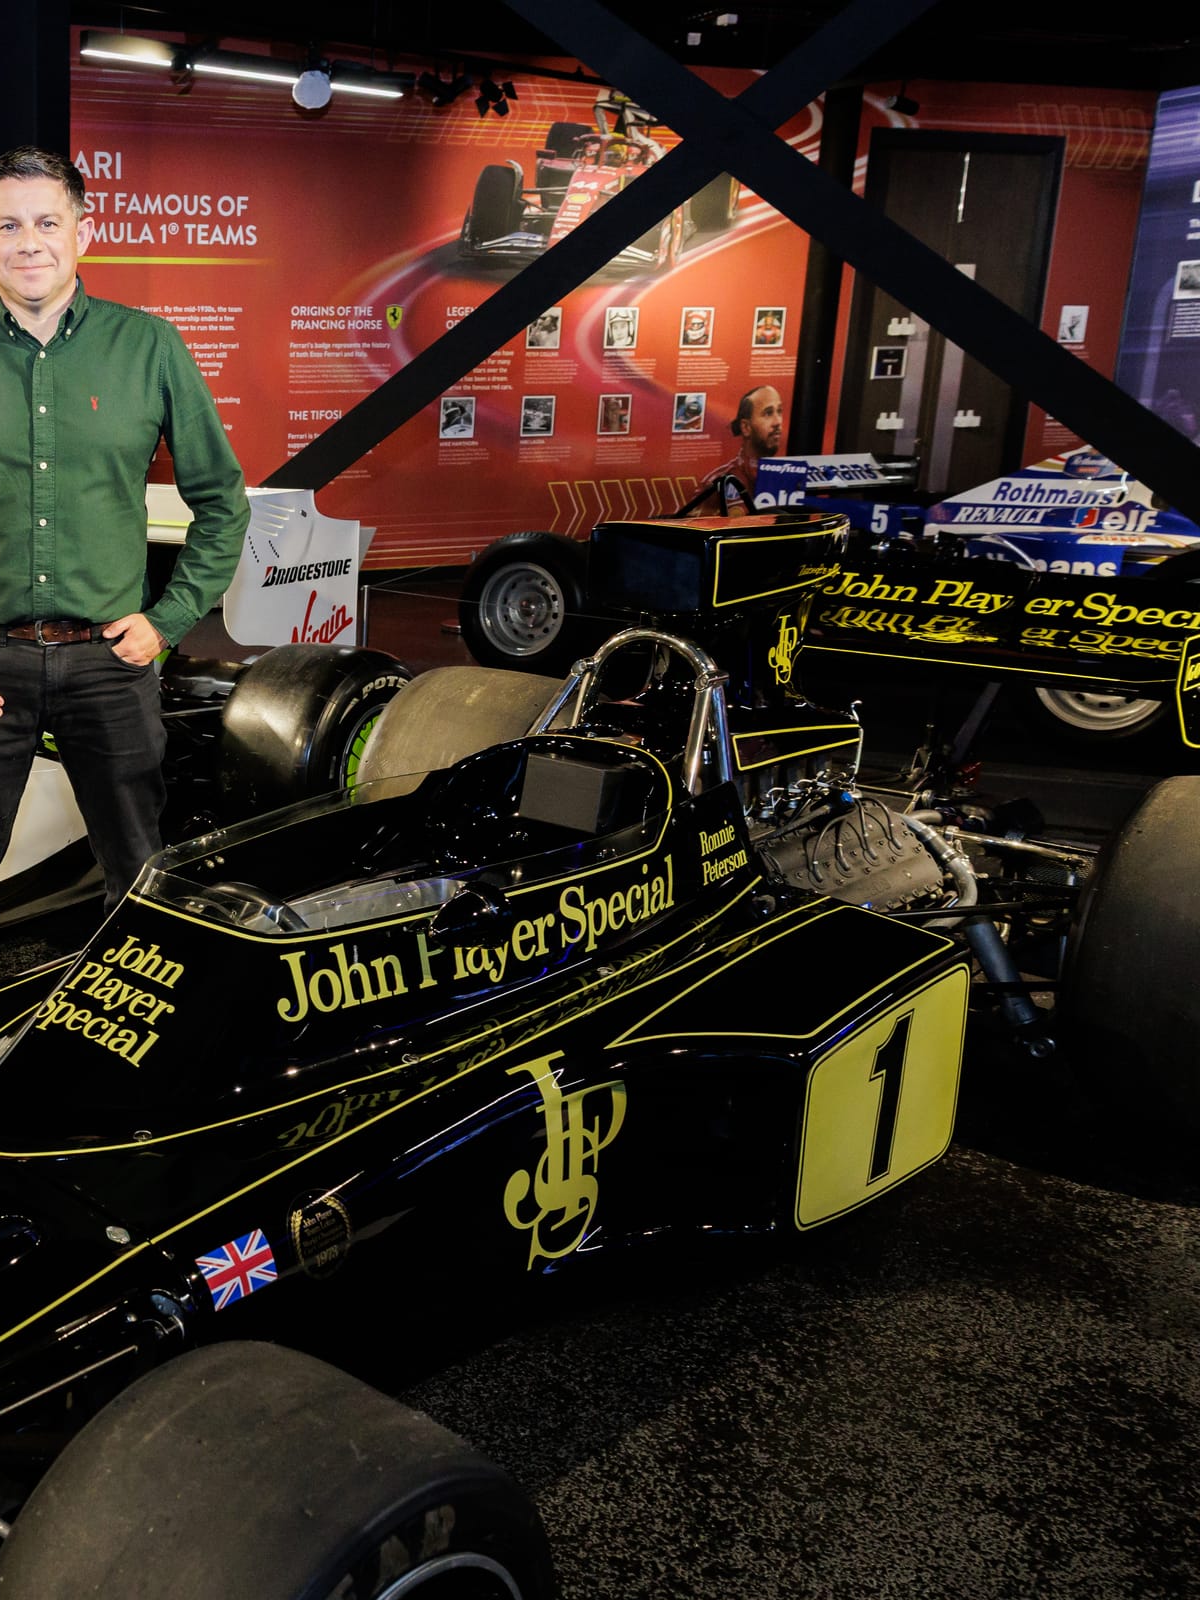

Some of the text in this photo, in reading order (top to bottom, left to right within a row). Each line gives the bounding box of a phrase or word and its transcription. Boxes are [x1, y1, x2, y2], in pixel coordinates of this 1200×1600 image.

[74, 150, 122, 180] ARI
[84, 192, 249, 217] ST FAMOUS OF
[92, 222, 155, 244] MULA
[184, 223, 257, 246] TEAMS
[290, 305, 373, 316] ORIGINS OF THE
[290, 319, 383, 330] PRANCING HORSE
[288, 409, 343, 421] THE TIFOSI
[759, 463, 807, 474] GOODYEAR
[754, 489, 806, 510] elf
[992, 481, 1116, 505] Rothmans
[870, 503, 890, 534] 5
[952, 507, 1051, 524] RENAULT
[1102, 509, 1160, 532] elf
[261, 558, 352, 588] BRIDGESTONE
[822, 571, 918, 602] John
[362, 674, 410, 698] POTE
[699, 819, 736, 857] Ronnie
[702, 849, 749, 886] Peterson
[277, 941, 409, 1023] John
[559, 853, 675, 953] Special
[102, 935, 185, 989] John
[64, 961, 176, 1026] Player
[35, 990, 160, 1068] Special
[866, 1008, 916, 1187] 1
